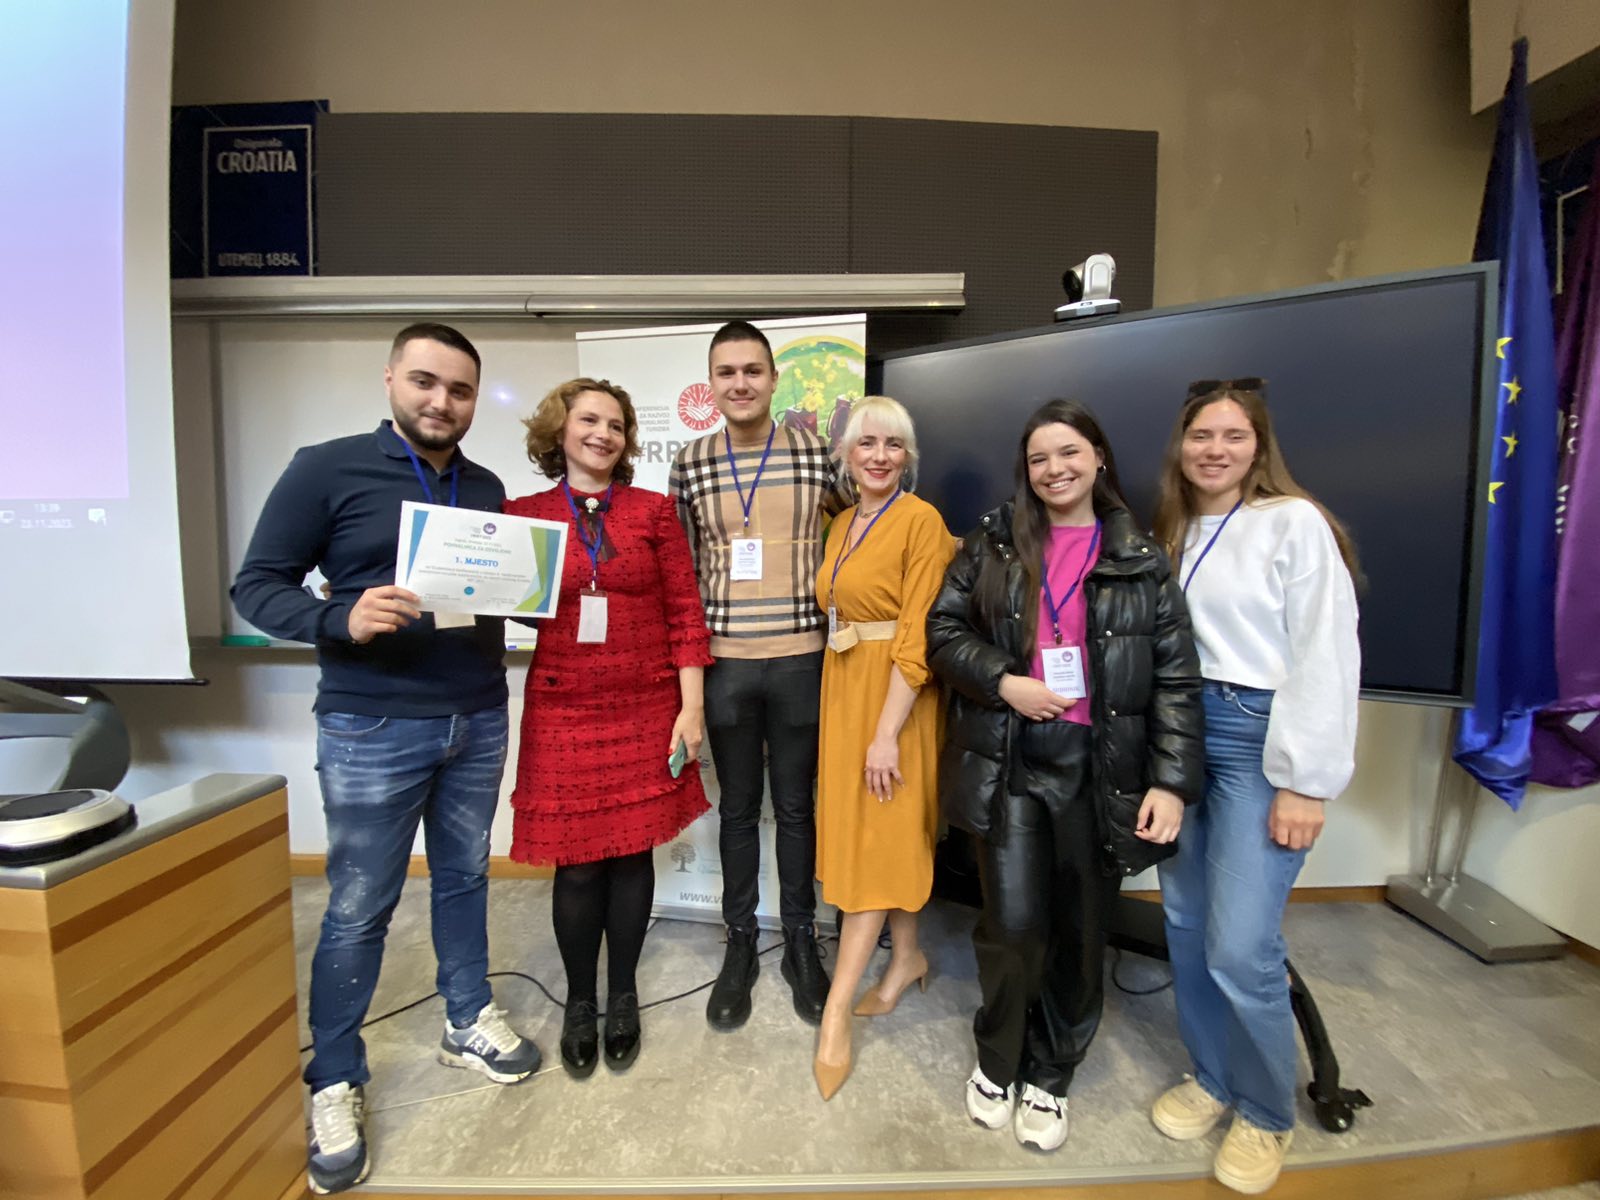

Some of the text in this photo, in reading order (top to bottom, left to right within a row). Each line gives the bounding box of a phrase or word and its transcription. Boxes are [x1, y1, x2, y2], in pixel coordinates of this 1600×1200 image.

[217, 150, 298, 173] CROATIA
[464, 557, 499, 568] MJESTO
[680, 891, 722, 904] www.v
